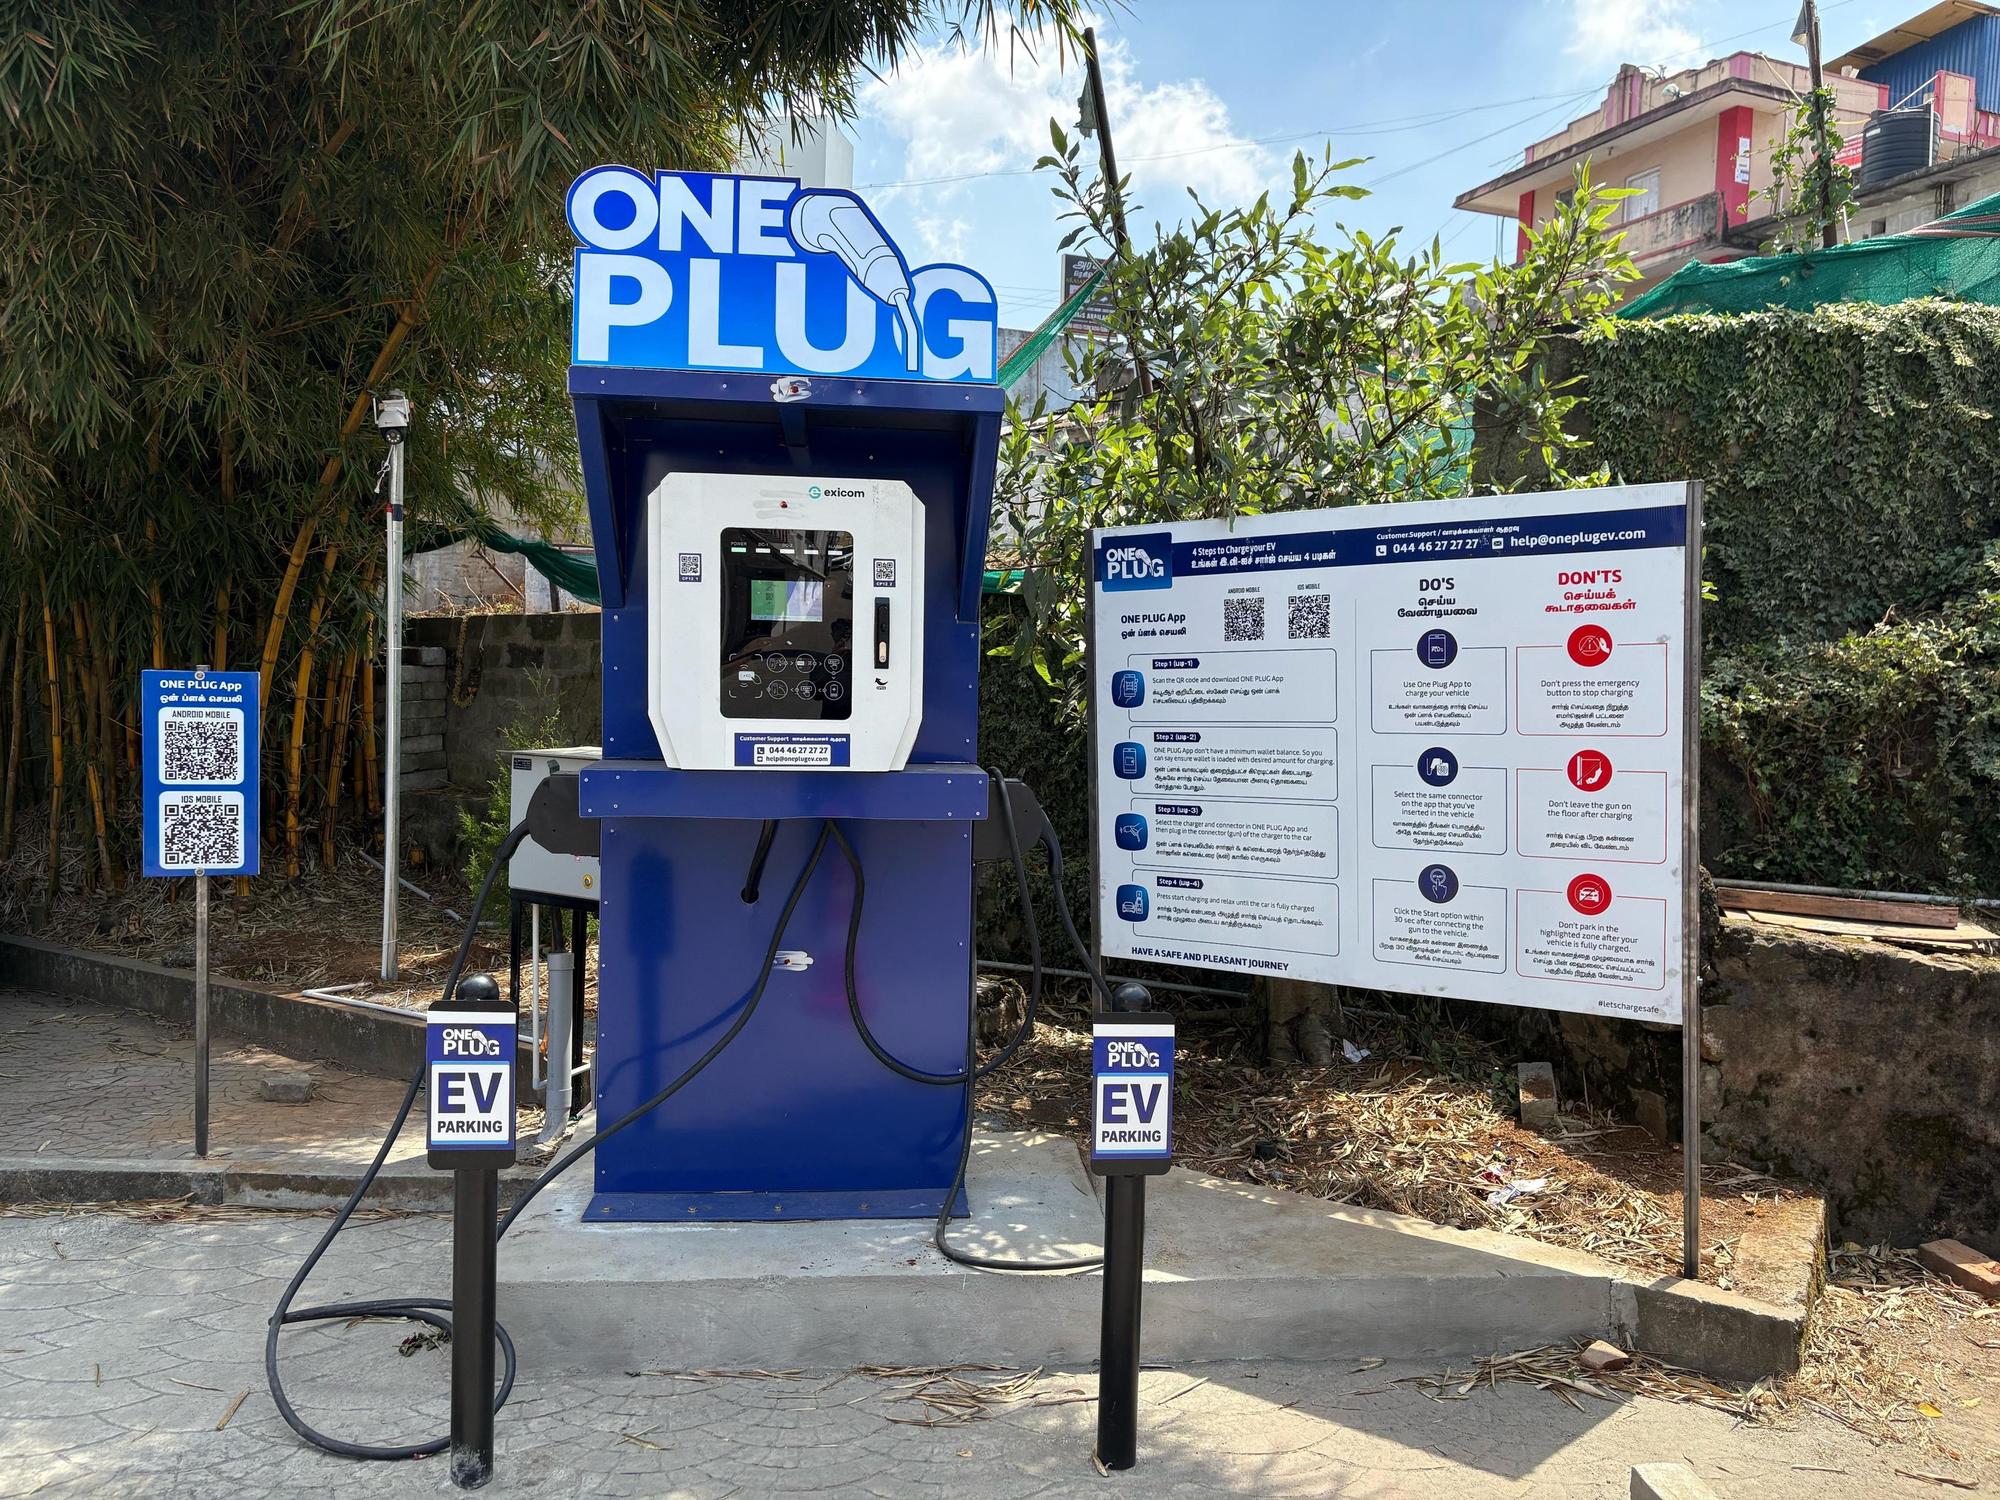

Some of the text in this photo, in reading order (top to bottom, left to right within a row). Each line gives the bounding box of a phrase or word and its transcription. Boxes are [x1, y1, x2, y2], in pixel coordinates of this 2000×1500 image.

[571, 171, 796, 256] ONE
[578, 253, 993, 379] PLUG
[824, 488, 865, 498] exicom
[1376, 531, 1408, 540] Customer
[1408, 530, 1436, 538] Support
[1511, 530, 1646, 547] help@oneplugev.com
[1192, 542, 1276, 556] 4 Steps to Charge your EV
[1393, 539, 1479, 553] 044 46 27 27 27
[1106, 548, 1135, 562] ONE
[1304, 552, 1310, 561] 4
[1107, 558, 1164, 579] PLUG
[1558, 570, 1622, 585] DON'TS
[1420, 578, 1454, 591] DO'S
[1564, 589, 1616, 600] செய்யக்
[1418, 595, 1456, 607] செய்ய
[1398, 606, 1478, 618] வேண்டியவை
[1121, 613, 1186, 624] ONE PLUG App
[160, 680, 242, 692] ONE PLUG App
[1432, 681, 1448, 689] Plug
[1449, 681, 1463, 689] App
[1562, 681, 1582, 689] press
[1597, 680, 1640, 688] emergency
[1405, 690, 1428, 698] charge
[1600, 689, 1634, 698] charging
[172, 710, 204, 718] ANDROID
[181, 795, 194, 803] IOS
[1549, 800, 1568, 808] Don't
[1570, 801, 1590, 809] leave
[1581, 810, 1599, 818] after
[1600, 812, 1632, 821] charging
[1185, 896, 1208, 904] charging
[1276, 902, 1290, 911] fully
[1290, 904, 1314, 913] charged
[1558, 921, 1578, 929] Don't
[1606, 925, 1619, 933] the
[1540, 929, 1580, 941] highlighted
[1582, 934, 1600, 942] zone
[1602, 934, 1620, 942] after
[1546, 939, 1631, 953] vehicle is fully charged.
[1132, 947, 1289, 971] HAVE A SAFE AND PLEASANT JOURNEY
[1598, 1000, 1659, 1014] #letschargesafe
[442, 1028, 473, 1040] ONE
[443, 1040, 500, 1055] PLUG
[1108, 1042, 1135, 1053] ONE
[1108, 1052, 1159, 1068] PLUG
[438, 1072, 503, 1114] EV
[1102, 1084, 1162, 1124] EV
[437, 1121, 503, 1133] PARKING
[1102, 1130, 1161, 1143] PARKING
